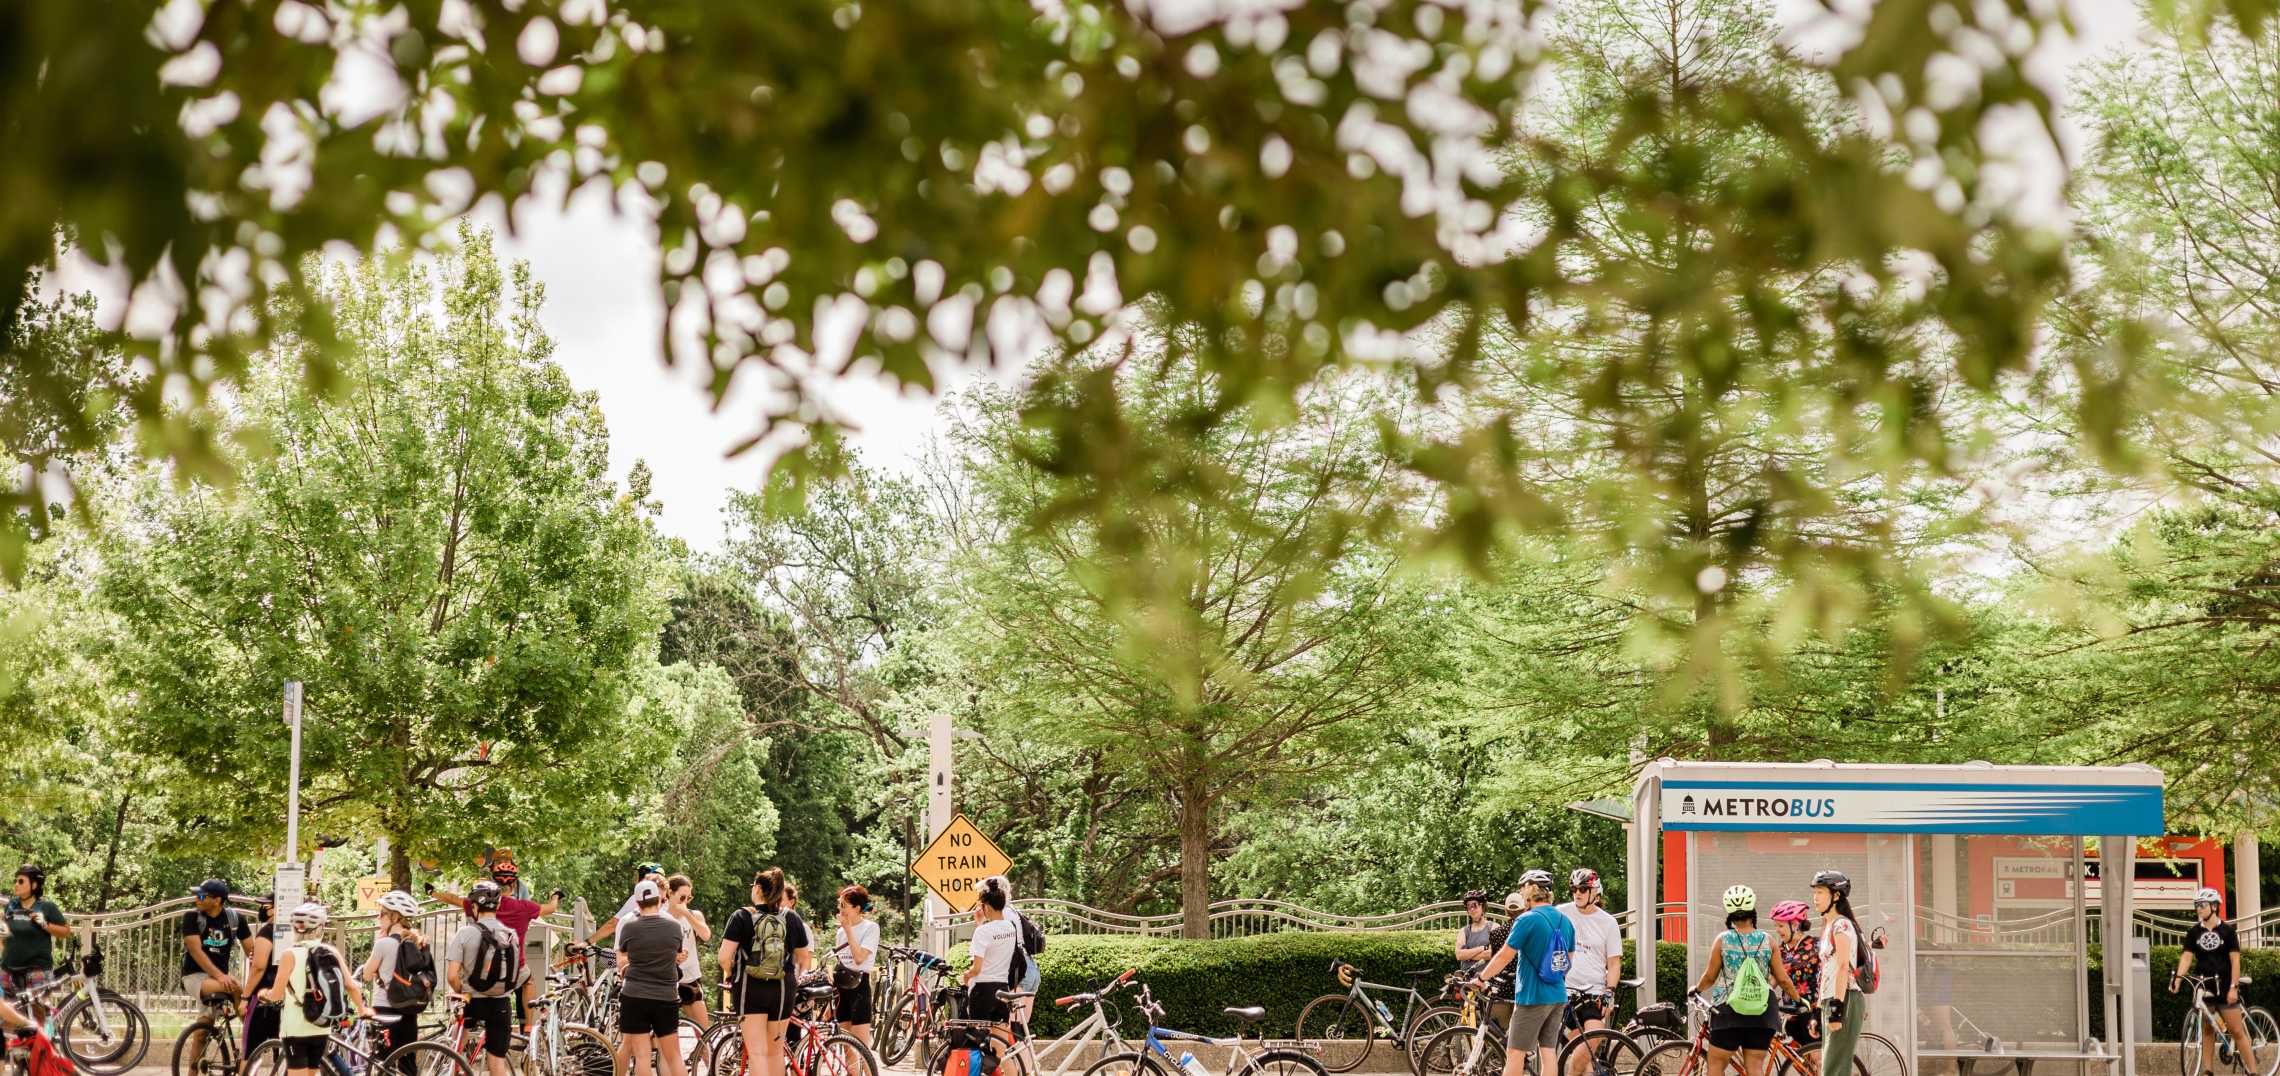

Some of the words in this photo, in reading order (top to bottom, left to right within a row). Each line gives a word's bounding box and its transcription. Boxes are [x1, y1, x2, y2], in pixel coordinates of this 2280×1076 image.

[1703, 798, 1835, 817] METROBUS
[950, 833, 971, 847] NO
[938, 855, 986, 870] TRAIN
[940, 878, 984, 892] HOR
